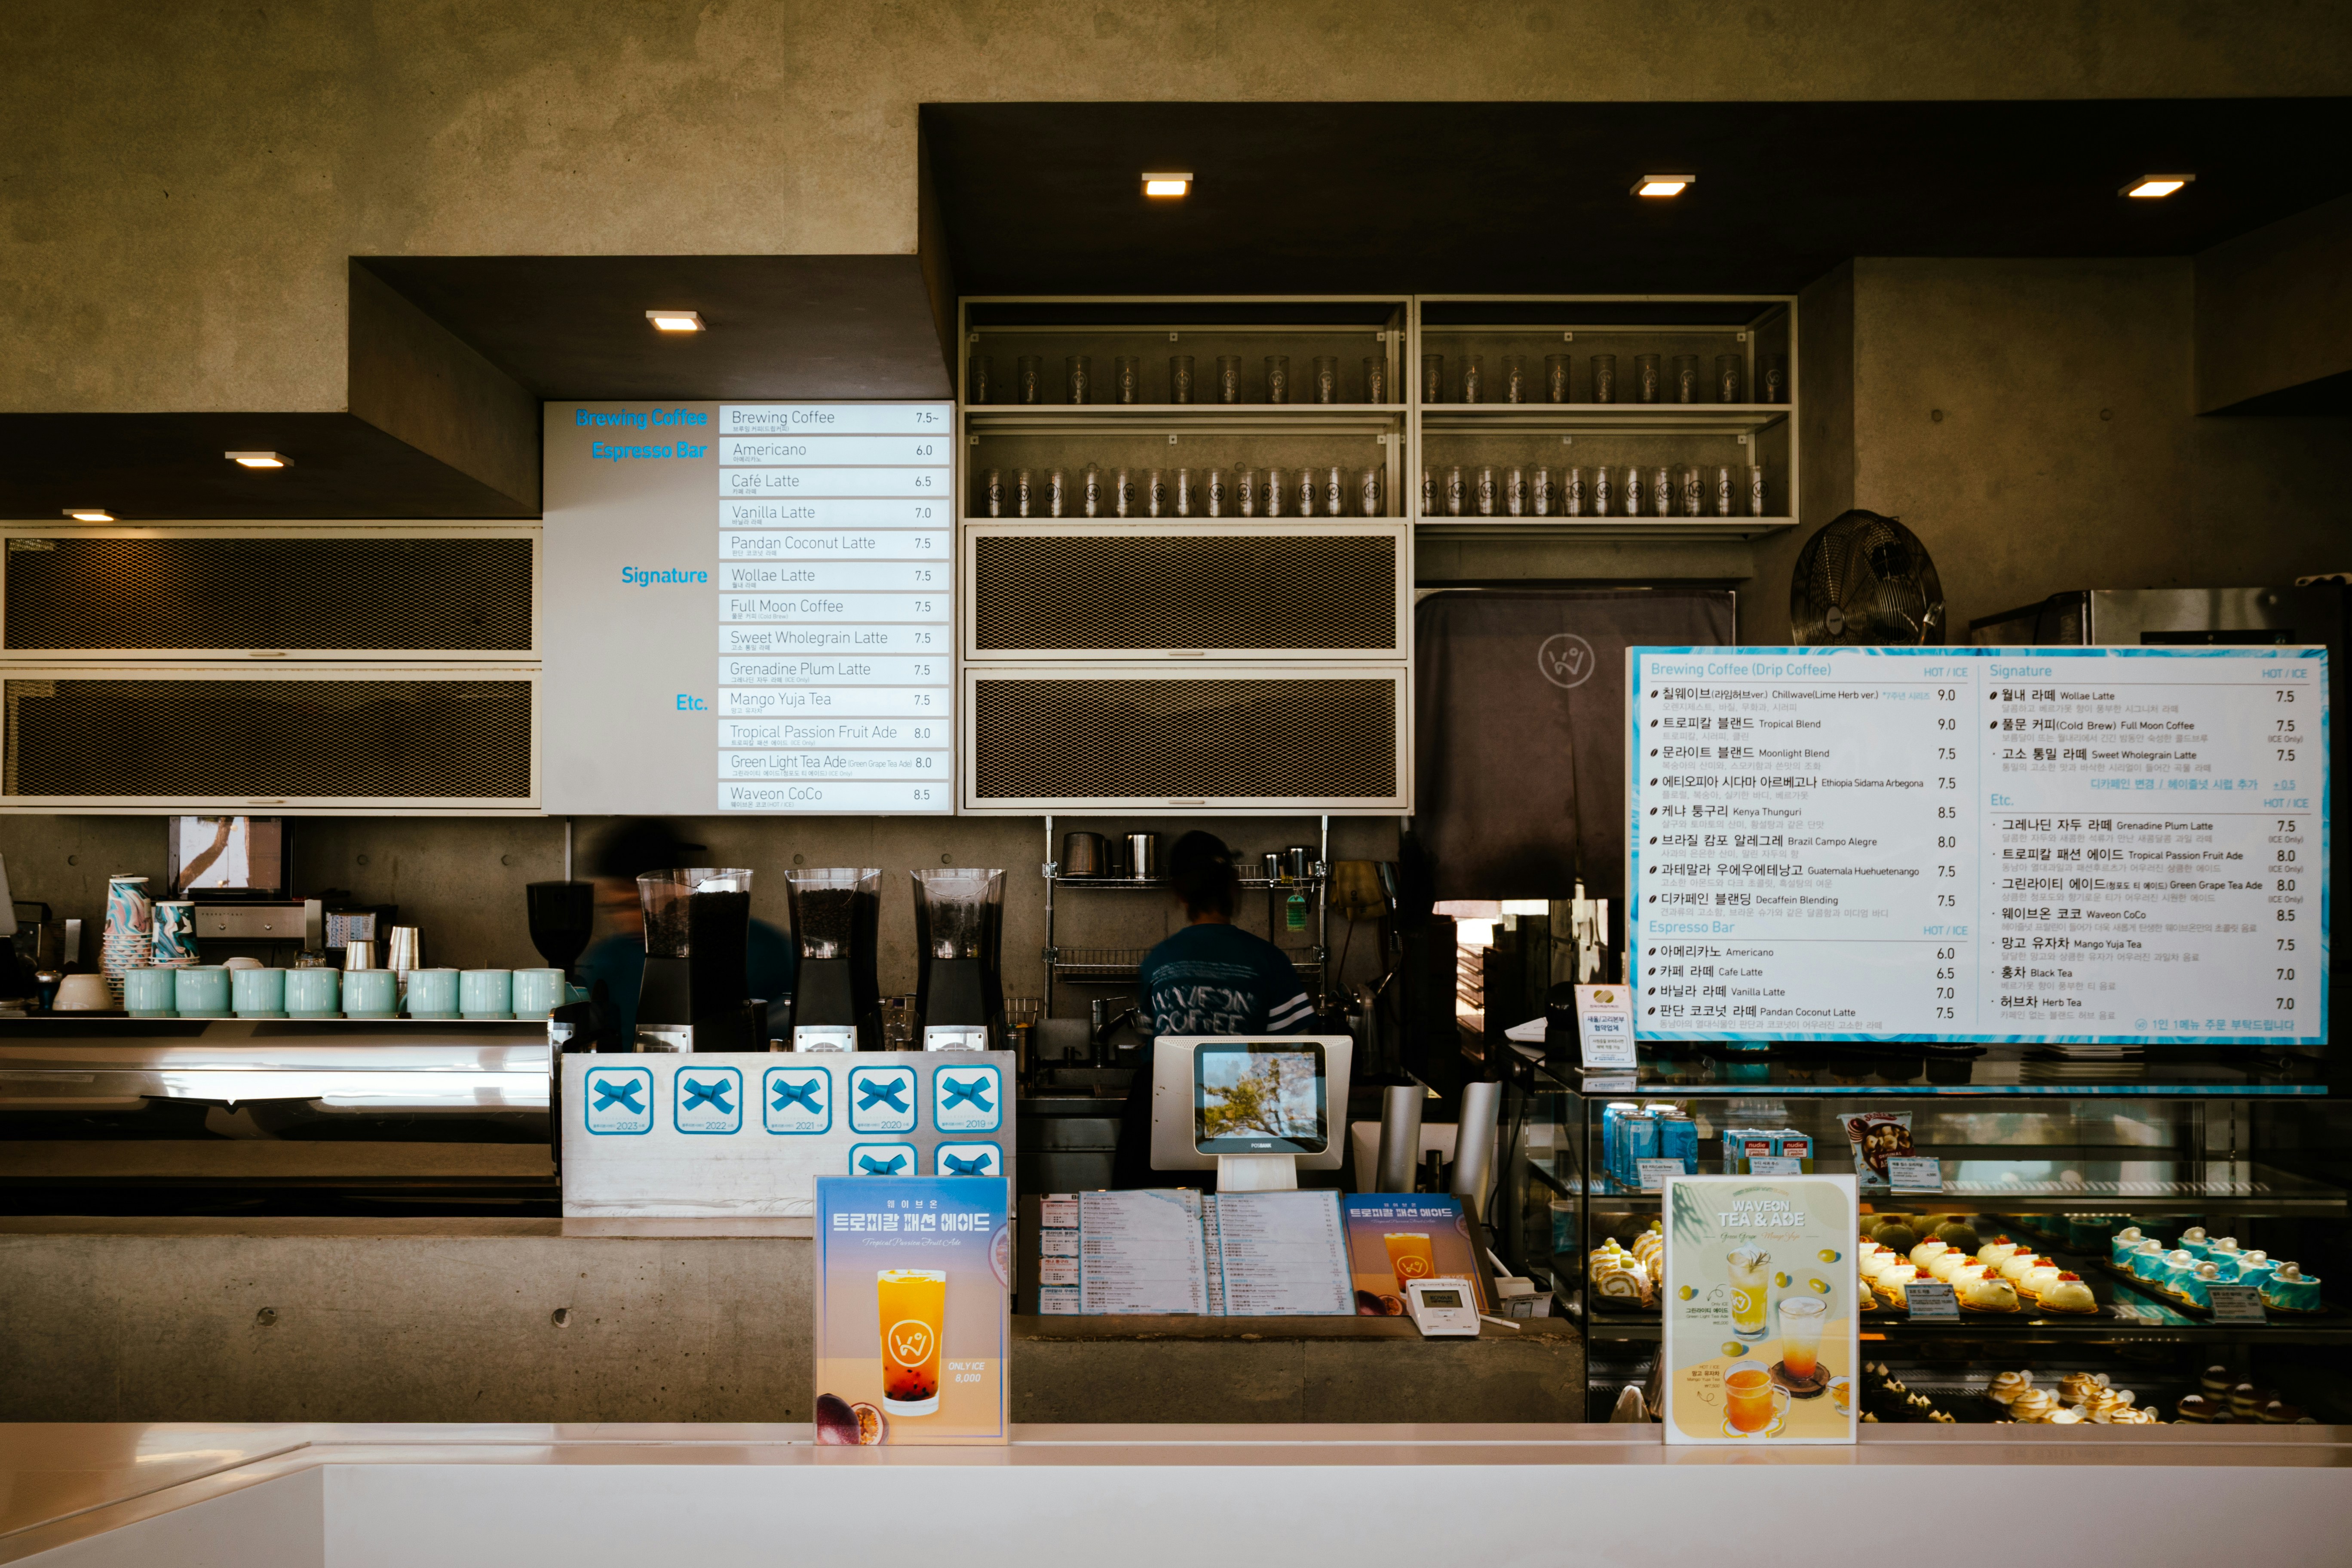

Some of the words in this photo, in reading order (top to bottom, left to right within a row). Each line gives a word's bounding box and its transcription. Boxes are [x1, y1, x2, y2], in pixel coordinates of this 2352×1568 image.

[576, 408, 648, 430] Brewing
[651, 408, 708, 427] Coffee
[732, 410, 787, 428] Brewing
[792, 410, 835, 423] Coffee
[916, 412, 939, 423] 7.5~
[592, 441, 673, 463] Espresso
[676, 442, 708, 459] Bar
[733, 443, 806, 456] Americano
[916, 445, 932, 456] 6.0
[732, 474, 761, 487] Café
[766, 474, 799, 487] Latte
[915, 476, 931, 487] 6.5
[732, 506, 777, 519] Vanilla
[782, 506, 815, 519] Latte
[915, 507, 931, 519] 7.0
[732, 536, 781, 549] Pandan
[785, 536, 838, 549] Coconut
[843, 536, 875, 549] Latte
[915, 538, 931, 549] 7.5
[621, 566, 708, 588] Signature
[731, 568, 777, 581] Wollae
[782, 568, 815, 581] Latte
[915, 570, 931, 581] 7.5
[731, 599, 755, 612] Full
[760, 599, 796, 612] Moon
[800, 599, 843, 612] Coffee
[915, 601, 931, 612] 7.5
[731, 630, 772, 644] Sweet
[775, 631, 850, 648] Wholegrain
[855, 631, 888, 644] Latte
[915, 632, 931, 644] 7.5
[730, 662, 797, 675] Grenadine
[800, 662, 834, 675] Plum
[838, 663, 871, 675] Latte
[914, 665, 930, 675] 7.5
[1652, 663, 1704, 678] Brewing
[1708, 663, 1748, 675] Coffee
[1752, 663, 1783, 677] (Drip
[1787, 663, 1831, 675] Coffee)
[1990, 664, 2052, 679] Signature
[730, 692, 775, 709] Mango
[778, 692, 805, 709] Yuja
[808, 692, 831, 705] Tea
[914, 694, 930, 706] 7.5
[1662, 687, 1768, 700] 칠웨이브(라임허브ver.)
[1772, 690, 1836, 699] Chillwave(Lime
[1838, 690, 1859, 699] Herb
[1861, 690, 1879, 700] ver.)
[1938, 689, 1956, 701] 9.0
[2002, 688, 2025, 702] 월내
[2032, 689, 2055, 702] 라떼
[2060, 692, 2090, 700] Wollae
[2092, 692, 2115, 700] Latte
[2276, 690, 2295, 703] 7.5
[677, 694, 708, 711] Etc.
[1663, 717, 1712, 730] 트로피칼
[1717, 717, 1754, 730] 블랜드
[1759, 719, 1794, 729] Tropical
[1796, 719, 1821, 728] Blend
[1938, 718, 1956, 730] 9.0
[730, 725, 780, 743] Tropical
[785, 725, 835, 738] Passion
[839, 725, 868, 738] Fruit
[871, 725, 897, 738] Ade
[914, 727, 930, 739] 8.0
[1662, 746, 1711, 759] 문라이트
[1717, 746, 1754, 759] 블랜드
[1759, 749, 1802, 759] Moonlight
[1804, 749, 1830, 758] Blend
[1938, 748, 1956, 760] 7.5
[731, 755, 766, 768] Green
[770, 755, 798, 772] Light
[800, 755, 820, 768] Tea
[823, 755, 846, 768] Ade
[849, 760, 867, 770] (Green
[868, 760, 886, 771] Grape
[915, 757, 932, 768] 8.0
[1662, 775, 1719, 788] 에티오피아
[1722, 776, 1757, 789] 시다마
[1760, 776, 1818, 789] 아르베고나
[1821, 778, 1852, 789] Ethiopia
[1854, 779, 1884, 787] Sidama
[1886, 779, 1924, 789] Arbegona
[1938, 777, 1956, 789] 7.5
[730, 787, 784, 800] Waveon
[788, 787, 822, 800] CoCo
[914, 789, 930, 800] 8.5
[1990, 793, 2014, 806] Etc.
[1662, 804, 1687, 817] 케냐
[1692, 805, 1728, 818] 퉁구리
[1733, 807, 1760, 817] Kenya
[1762, 807, 1801, 818] Thunguri
[1938, 806, 1956, 819] 8.5
[1661, 893, 1708, 905] 디카페인
[1715, 893, 1751, 906] 블랜딩
[1756, 895, 1797, 904] Decaffein
[1800, 896, 1838, 906] Blending
[1938, 895, 1955, 907] 7.5
[2002, 907, 2051, 921] 웨이브온
[2057, 908, 2082, 919] 코코
[2086, 910, 2121, 919] Waveon
[2123, 910, 2147, 919] CoCo
[2276, 909, 2295, 922] 8.5
[1650, 921, 1708, 934] Espresso
[1713, 921, 1735, 933] Bar
[1660, 945, 1721, 958] 아메리카노
[1726, 948, 1774, 957] Americano
[1937, 947, 1955, 960] 6.0
[2001, 965, 2027, 979] 홍차
[2030, 968, 2055, 977] Black
[2057, 969, 2073, 977] Tea
[2276, 968, 2295, 981] 7.0
[966, 1120, 986, 1128] 2019
[1733, 1200, 1790, 1212] WAVEON
[833, 1213, 899, 1231] 트로피칼
[904, 1213, 936, 1231] 패션
[941, 1213, 990, 1231] 에이드
[1718, 1212, 1751, 1227] TEA
[1754, 1212, 1768, 1227] &
[1770, 1212, 1805, 1227] ADE
[949, 1362, 971, 1370] ONLY
[972, 1362, 984, 1370] ICE
[956, 1374, 981, 1383] 8,000
